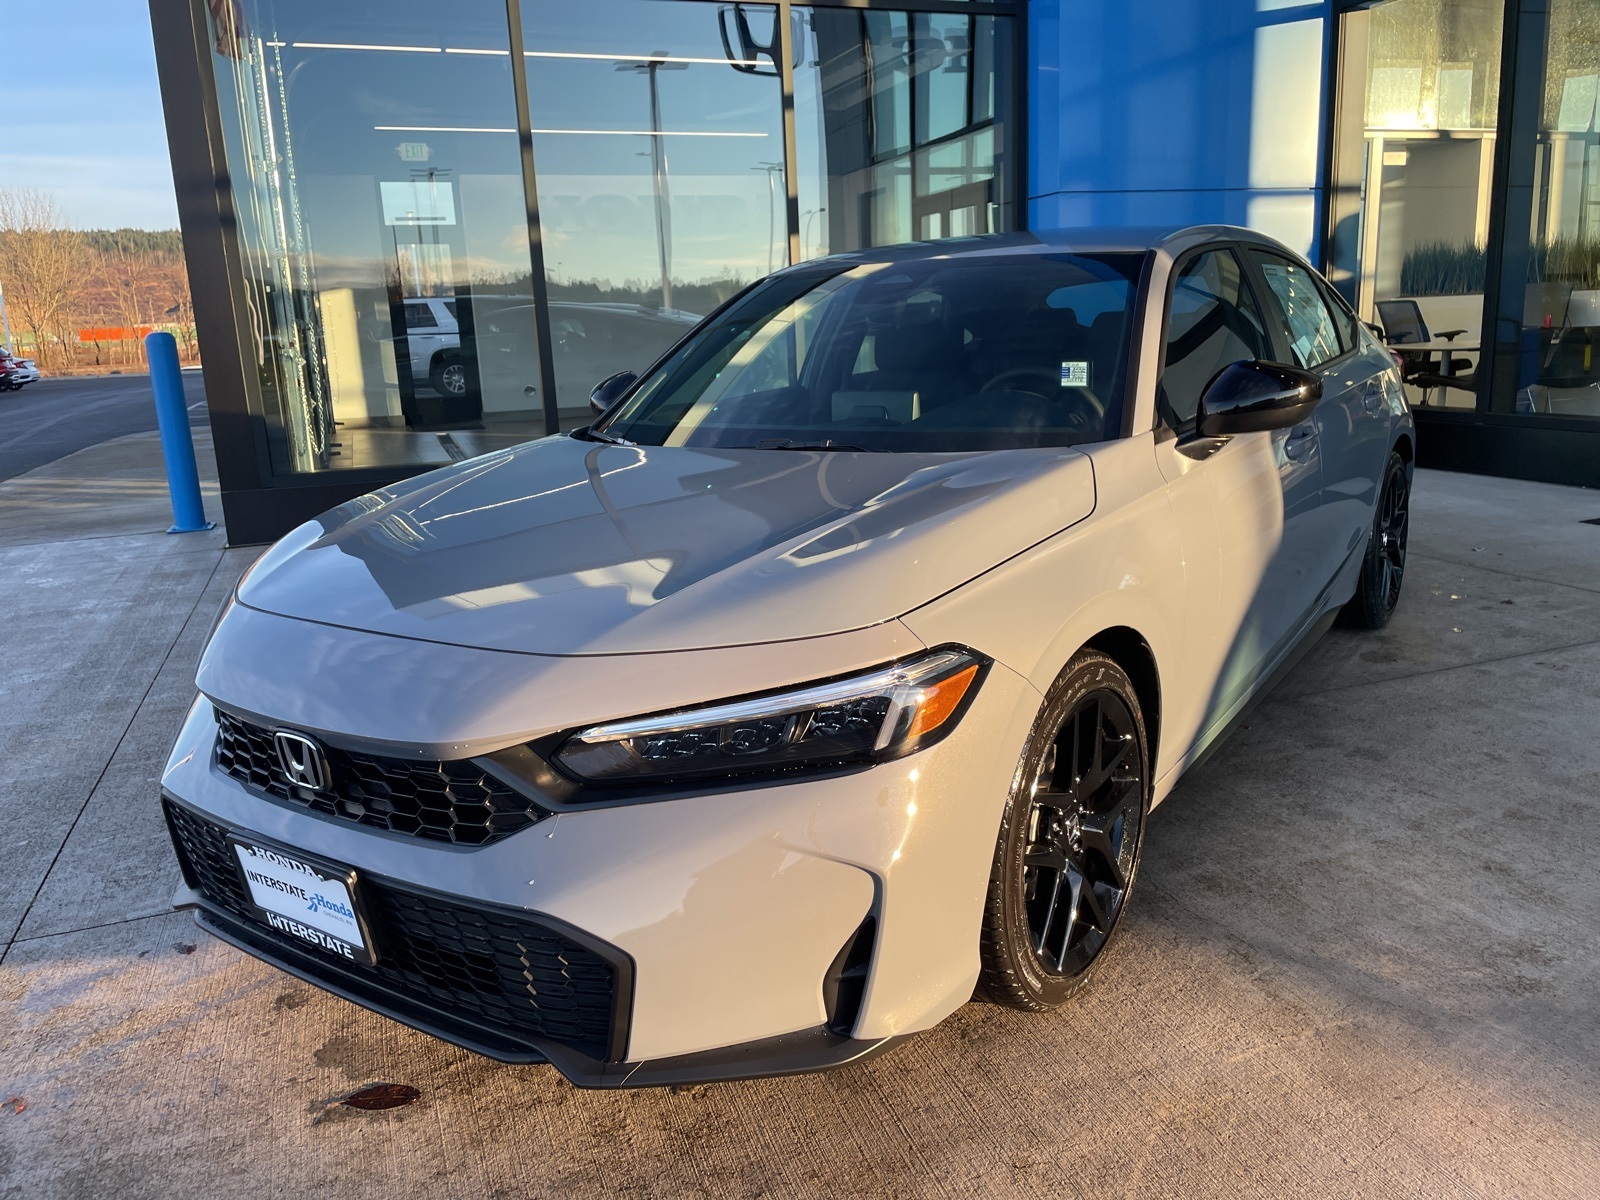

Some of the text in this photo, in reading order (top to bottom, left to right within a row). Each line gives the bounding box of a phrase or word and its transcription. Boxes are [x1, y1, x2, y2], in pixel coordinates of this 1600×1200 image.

[404, 144, 425, 159] EXIT
[250, 846, 318, 877] HONDA
[246, 869, 355, 919] INTERSTATE Honda
[266, 911, 354, 959] INTERSTATE
